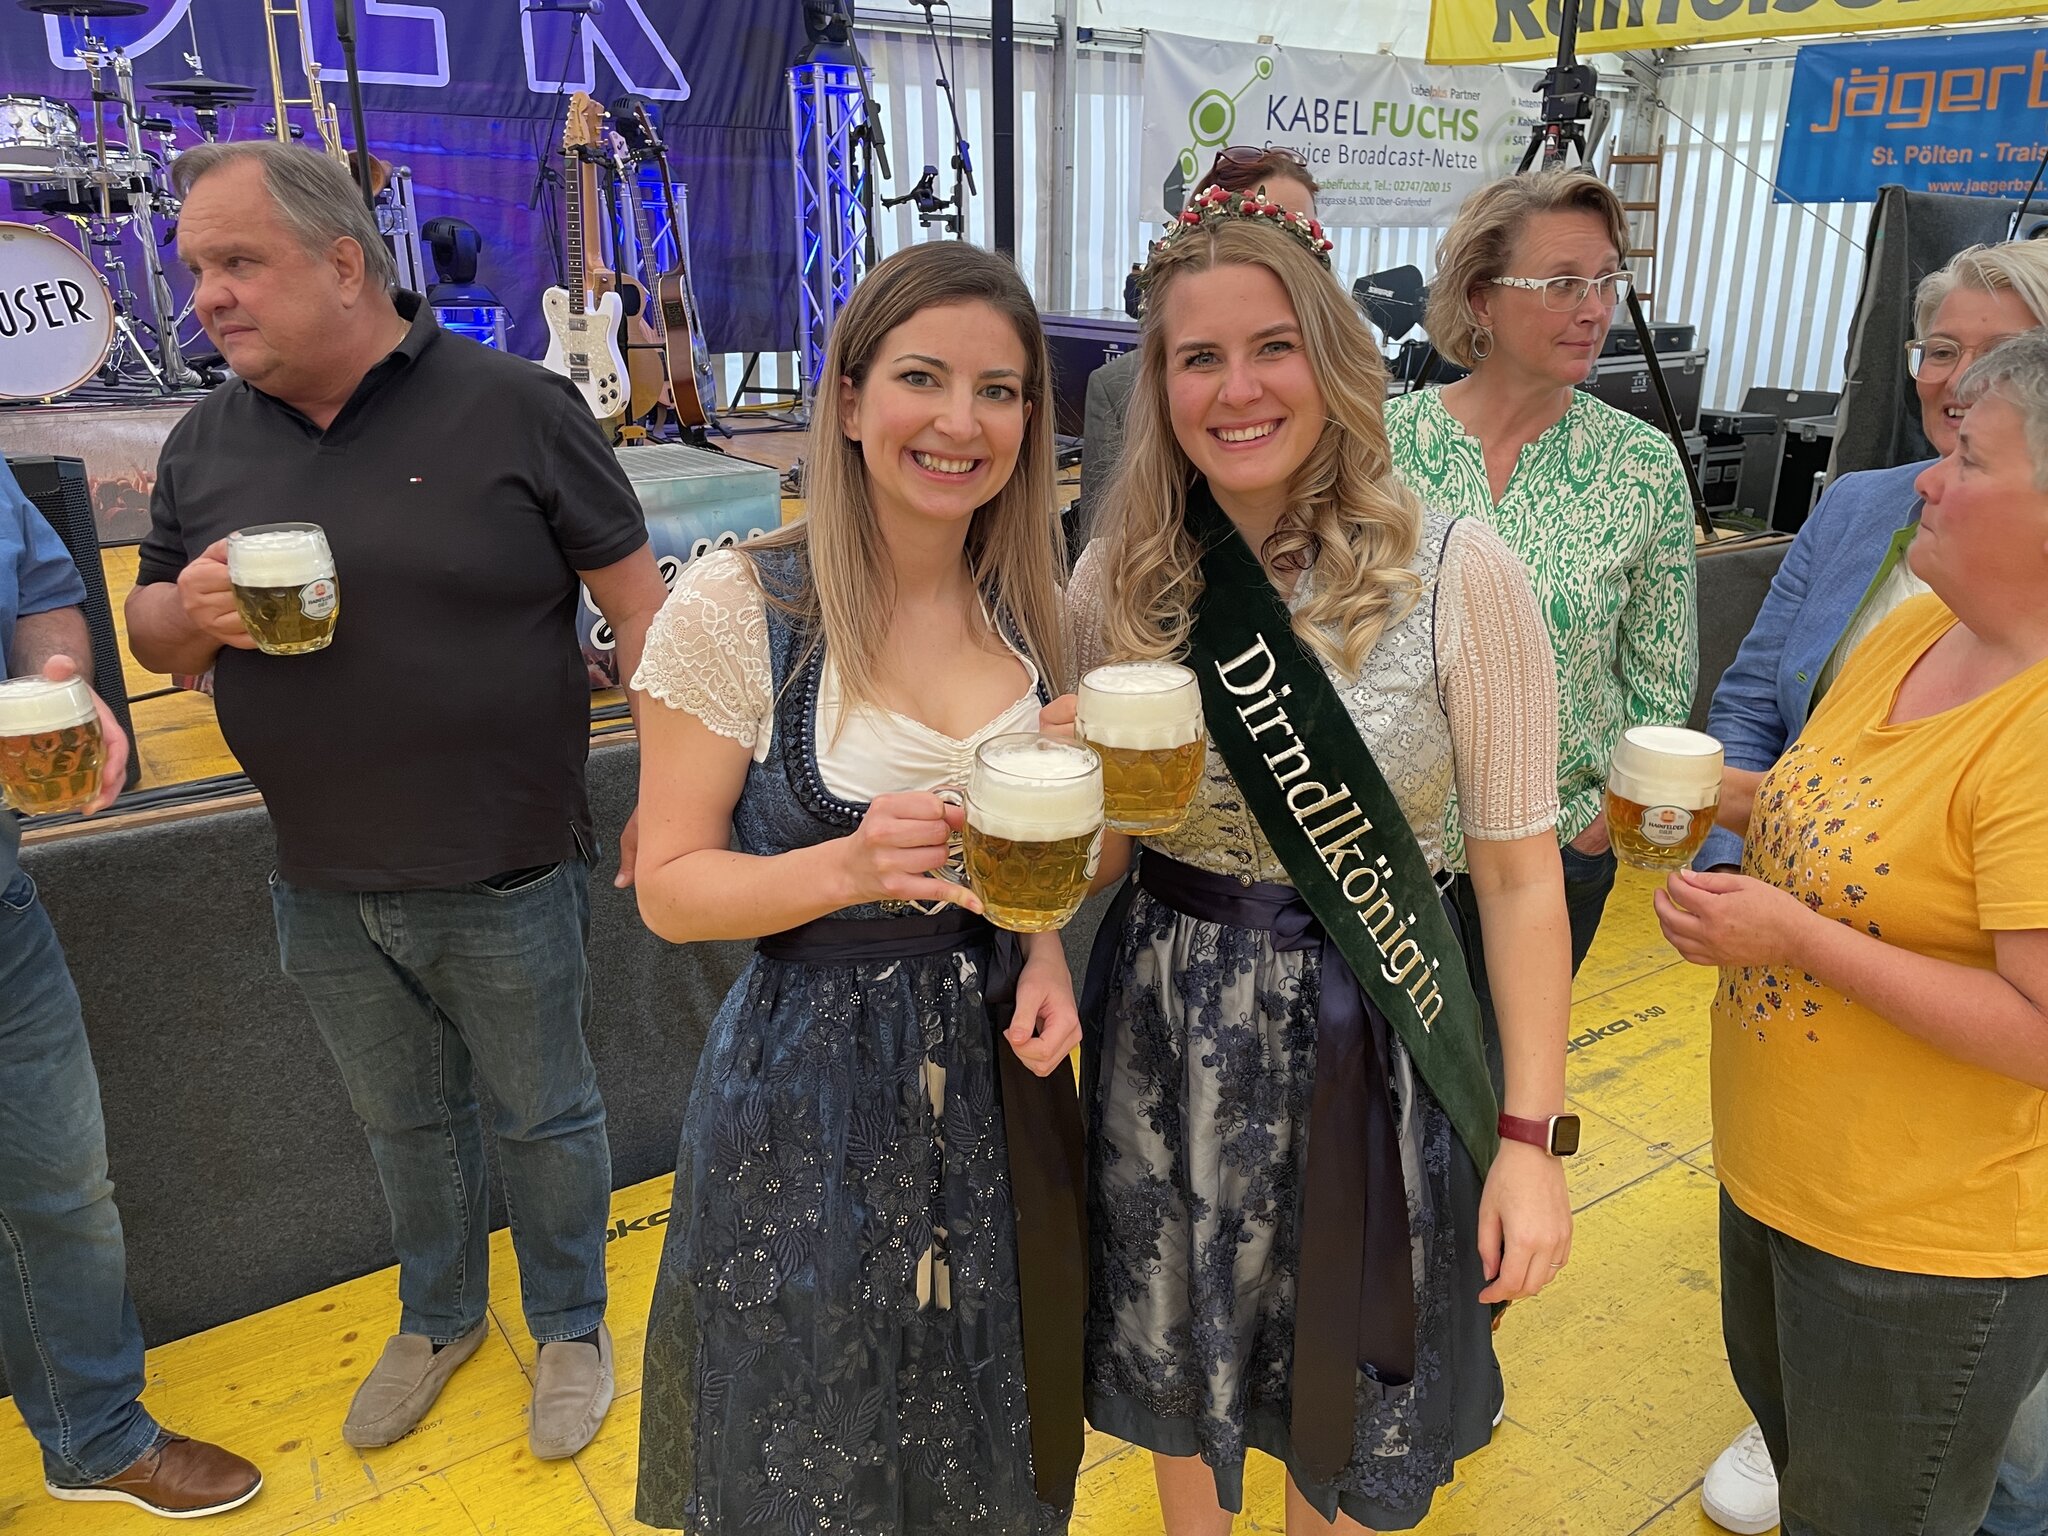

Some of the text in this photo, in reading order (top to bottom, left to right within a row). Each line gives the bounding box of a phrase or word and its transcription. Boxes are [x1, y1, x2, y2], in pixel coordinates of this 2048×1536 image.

[1450, 88, 1480, 100] Partner
[1265, 94, 1480, 142] KABELFUCHS
[1338, 144, 1478, 169] Broadcast-Netze
[1872, 147, 1898, 166] St.
[1904, 146, 1973, 165] Pölten
[1393, 180, 1440, 193] 02747/200
[1441, 182, 1452, 192] 15
[1214, 632, 1445, 1033] Dirndlkönigin
